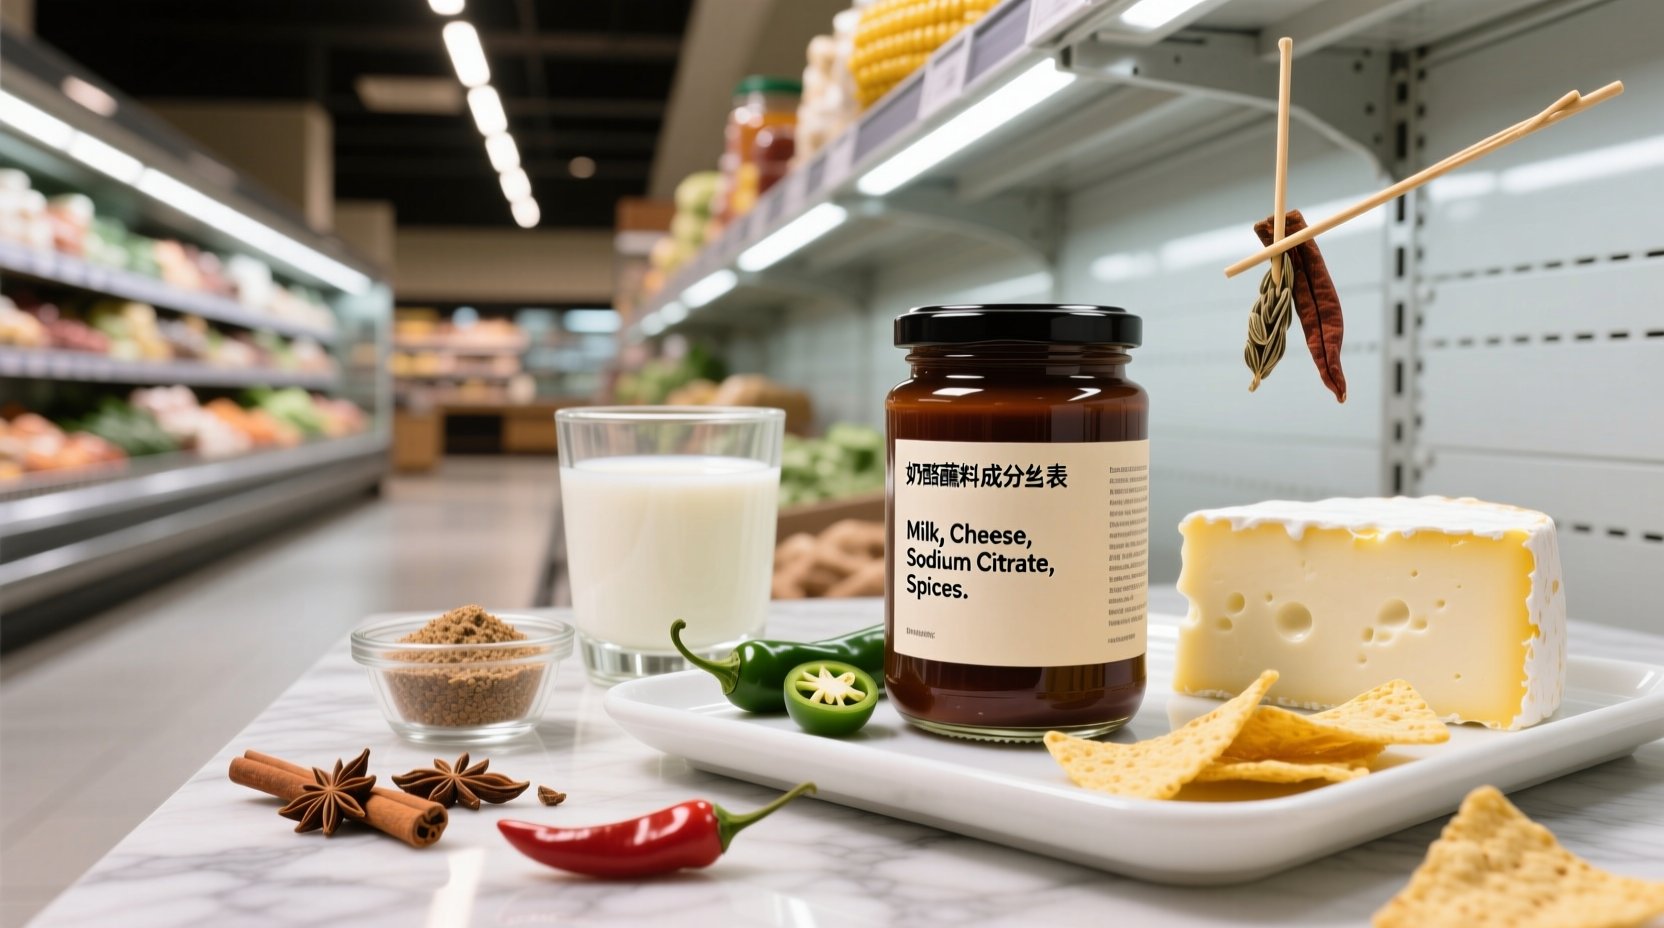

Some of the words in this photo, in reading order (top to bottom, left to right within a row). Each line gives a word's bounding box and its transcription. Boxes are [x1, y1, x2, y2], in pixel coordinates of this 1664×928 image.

[906, 520, 946, 547] Milk,
[949, 523, 1032, 549] Cheese,
[906, 547, 972, 571] Sodium
[976, 551, 1055, 577] Citrate,
[906, 574, 969, 600] Spices.
